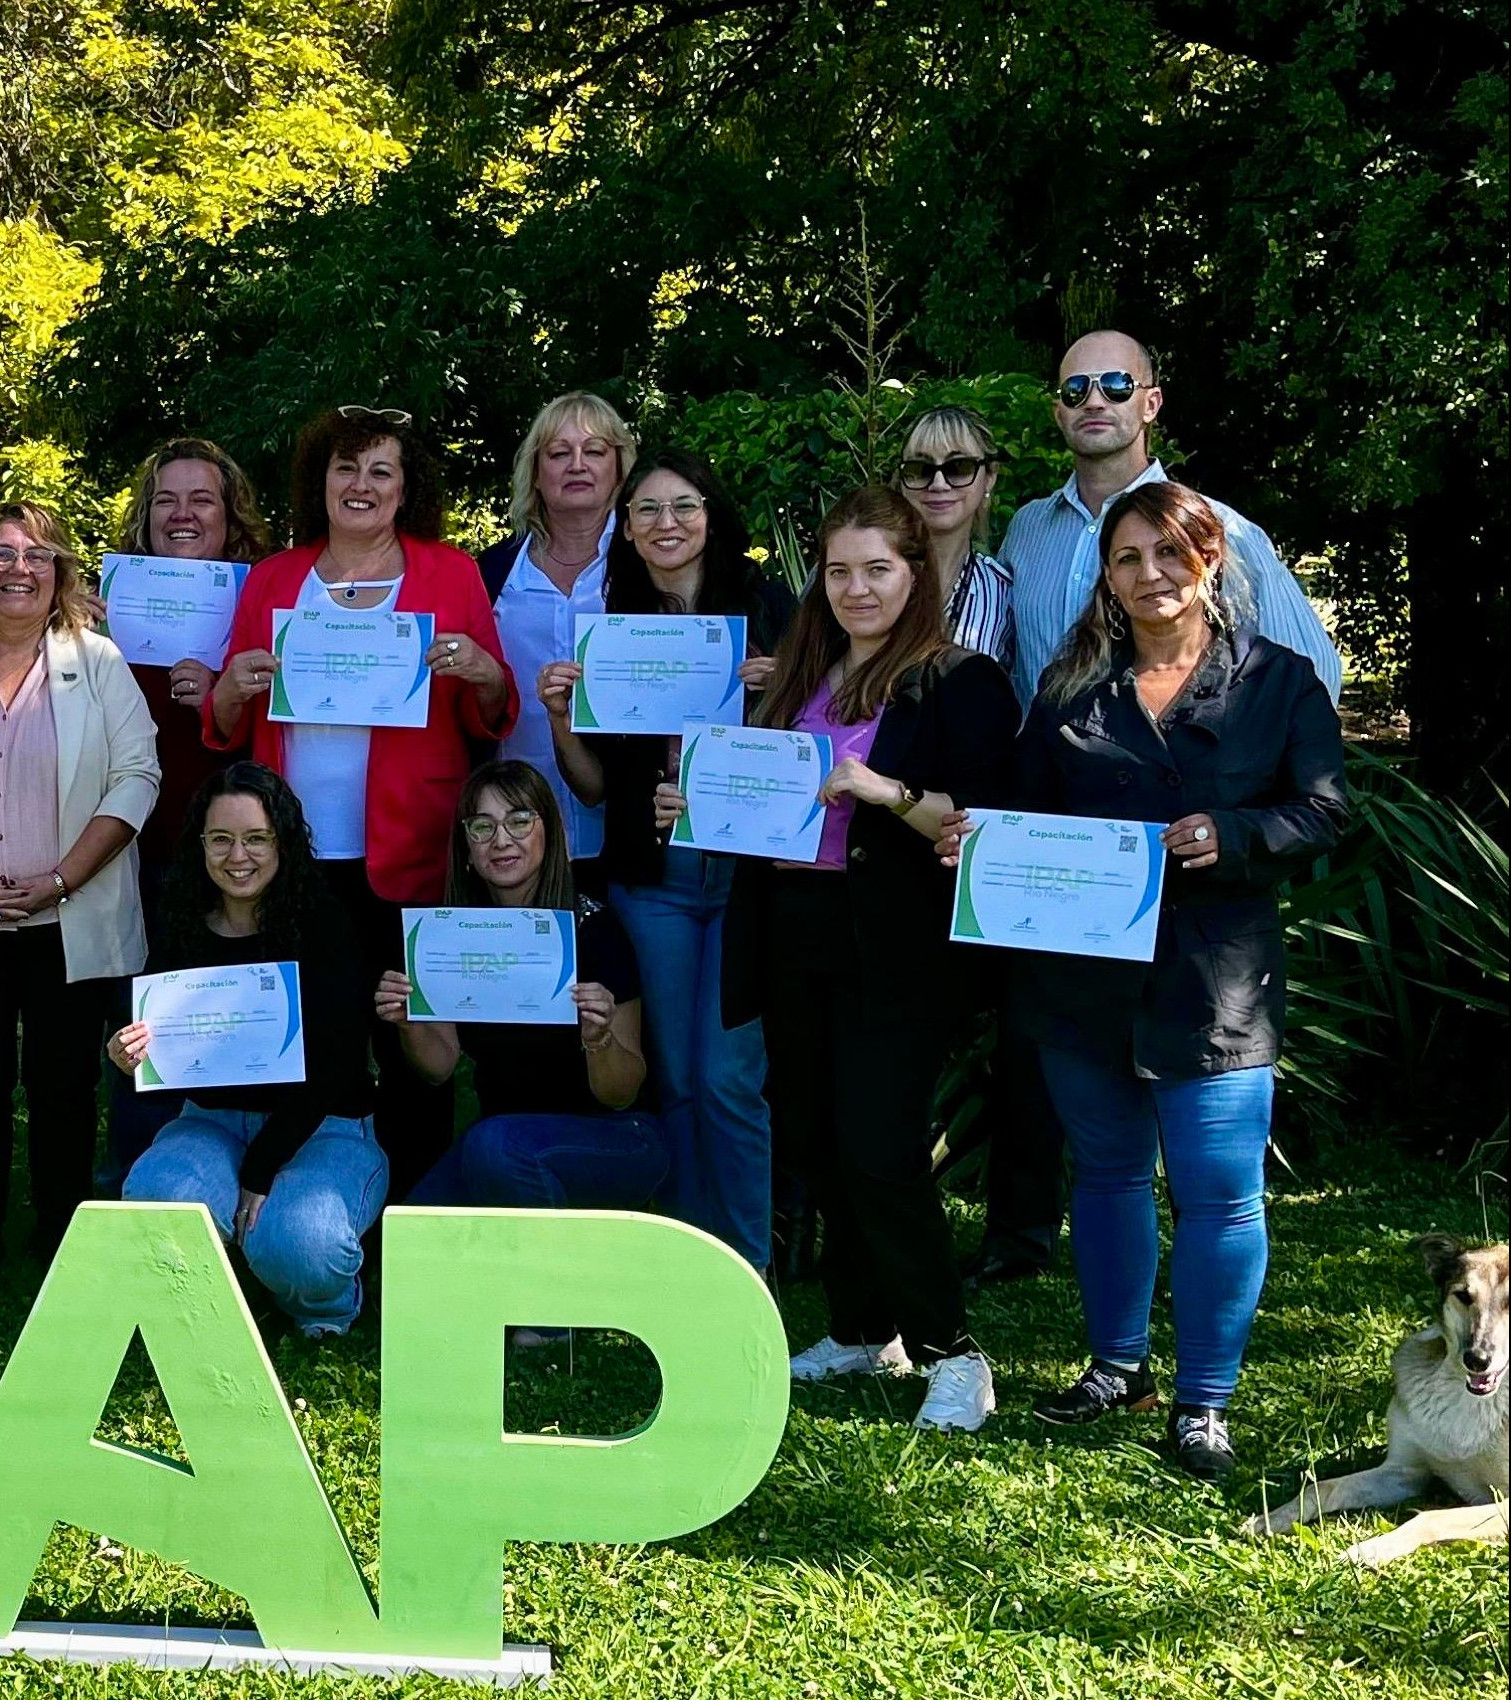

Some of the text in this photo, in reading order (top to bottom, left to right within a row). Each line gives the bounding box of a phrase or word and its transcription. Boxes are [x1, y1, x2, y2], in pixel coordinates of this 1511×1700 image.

[149, 569, 194, 578] Capacitación
[630, 629, 684, 637] Capacitación
[1029, 830, 1093, 842] Capacitación
[459, 921, 512, 929] Capacitación
[185, 980, 238, 989] Capacitación
